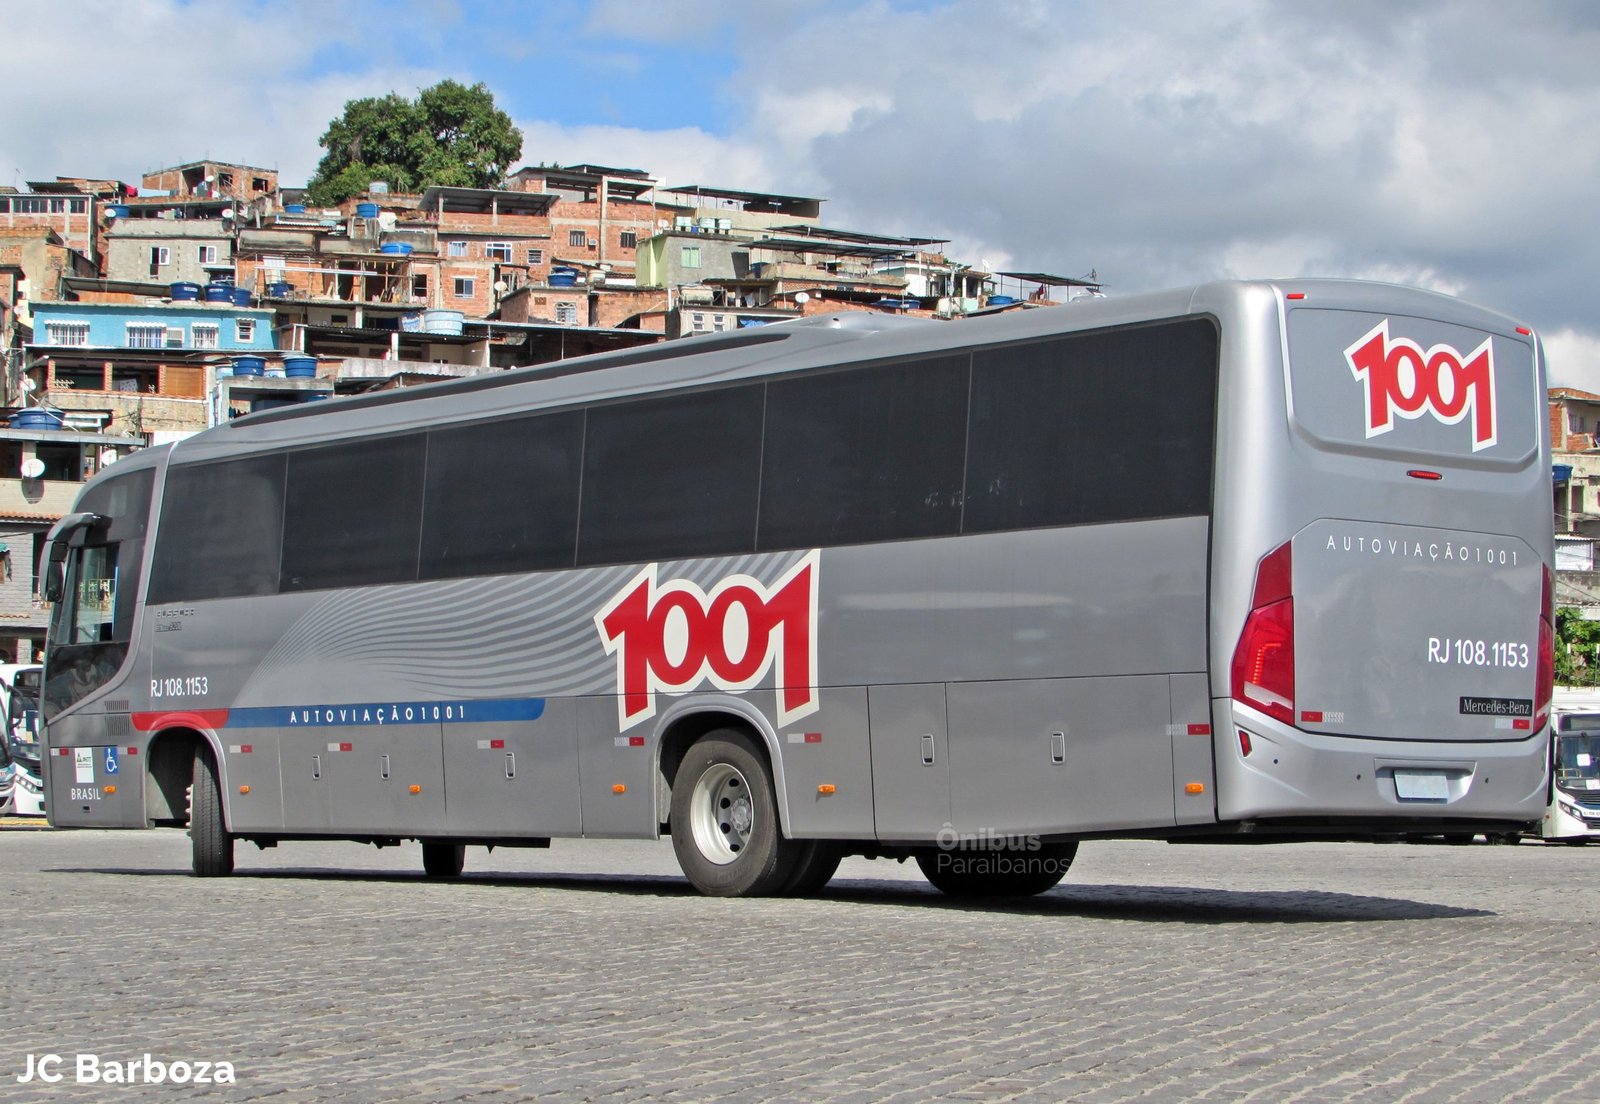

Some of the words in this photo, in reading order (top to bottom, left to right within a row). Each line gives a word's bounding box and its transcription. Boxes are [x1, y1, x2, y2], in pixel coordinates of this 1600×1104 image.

[1343, 318, 1497, 453] 1001
[594, 548, 820, 733] 1001
[1428, 637, 1450, 663] RJ
[1455, 639, 1529, 668] 108.1153
[150, 679, 163, 697] RJ
[164, 676, 208, 697] 108.1153
[1463, 698, 1530, 715] Mercedes-Benz
[71, 787, 101, 800] BRASIL
